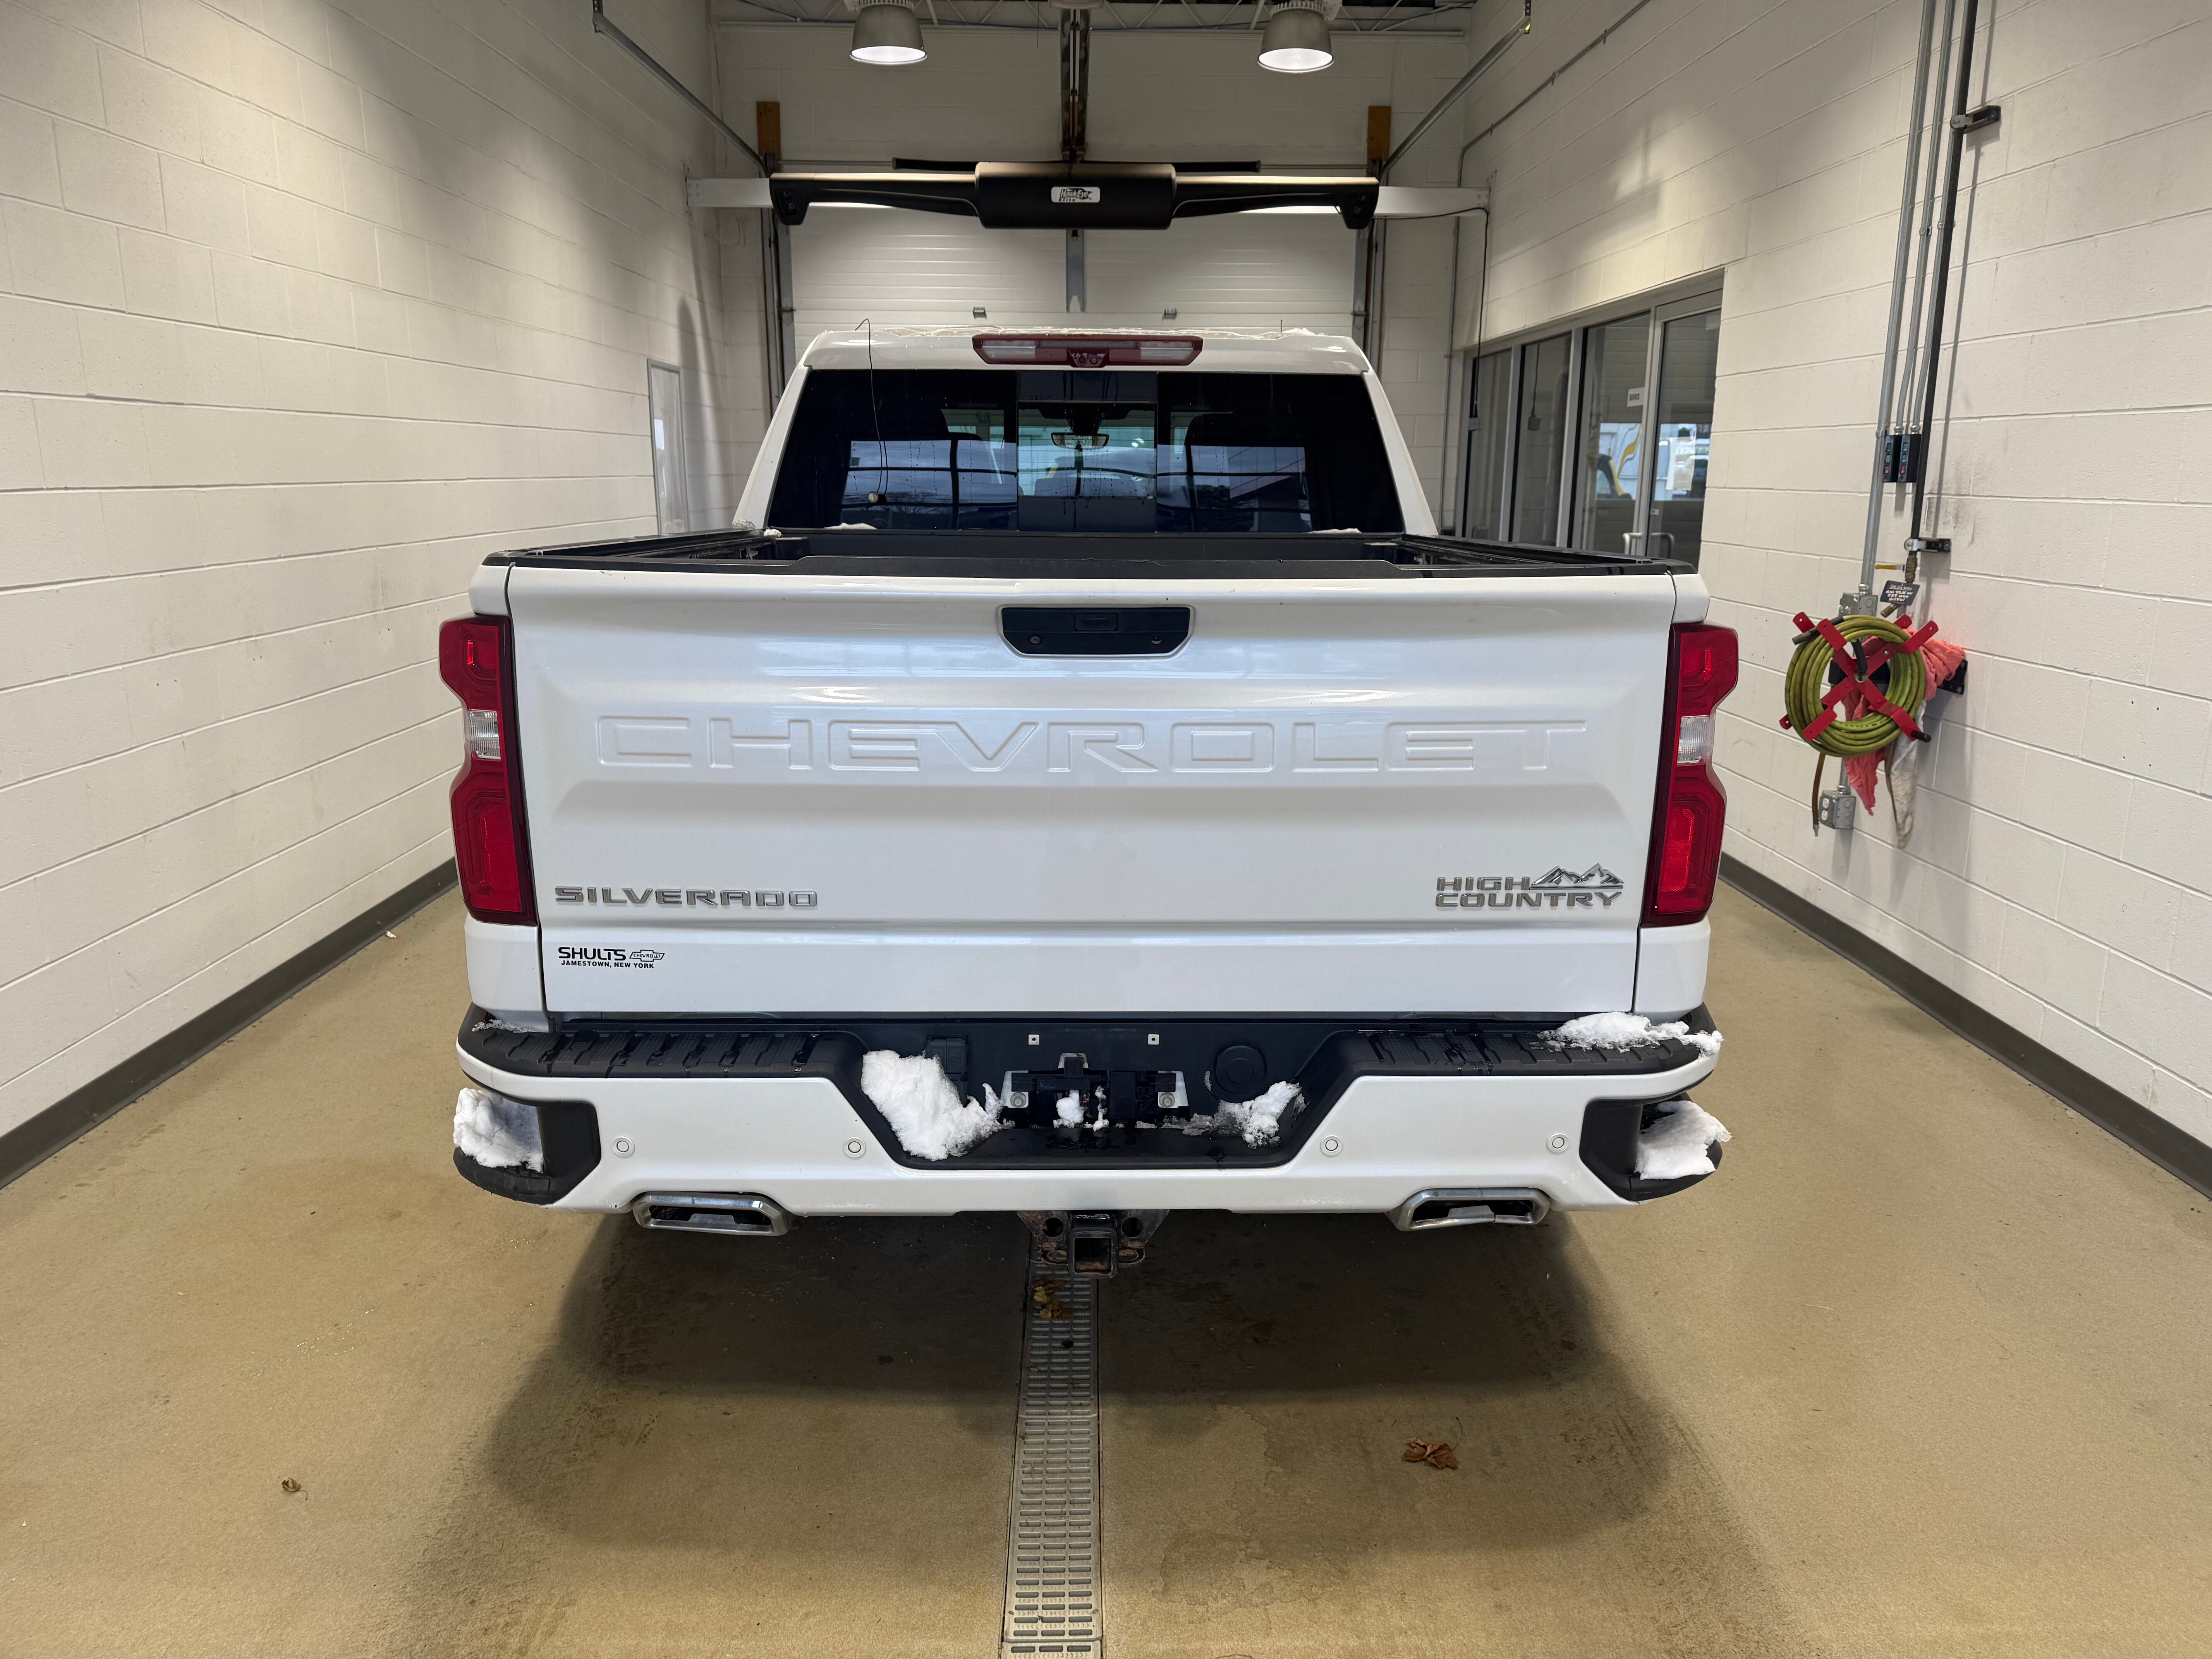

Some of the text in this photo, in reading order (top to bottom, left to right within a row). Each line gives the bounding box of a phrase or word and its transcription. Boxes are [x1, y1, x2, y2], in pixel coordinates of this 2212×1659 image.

[596, 716, 1587, 773] CHEVROLET
[1436, 876, 1530, 891] HIGH
[555, 886, 818, 907] SILVERADO
[1435, 892, 1622, 907] COUNTRY
[558, 947, 626, 961] SHULTS
